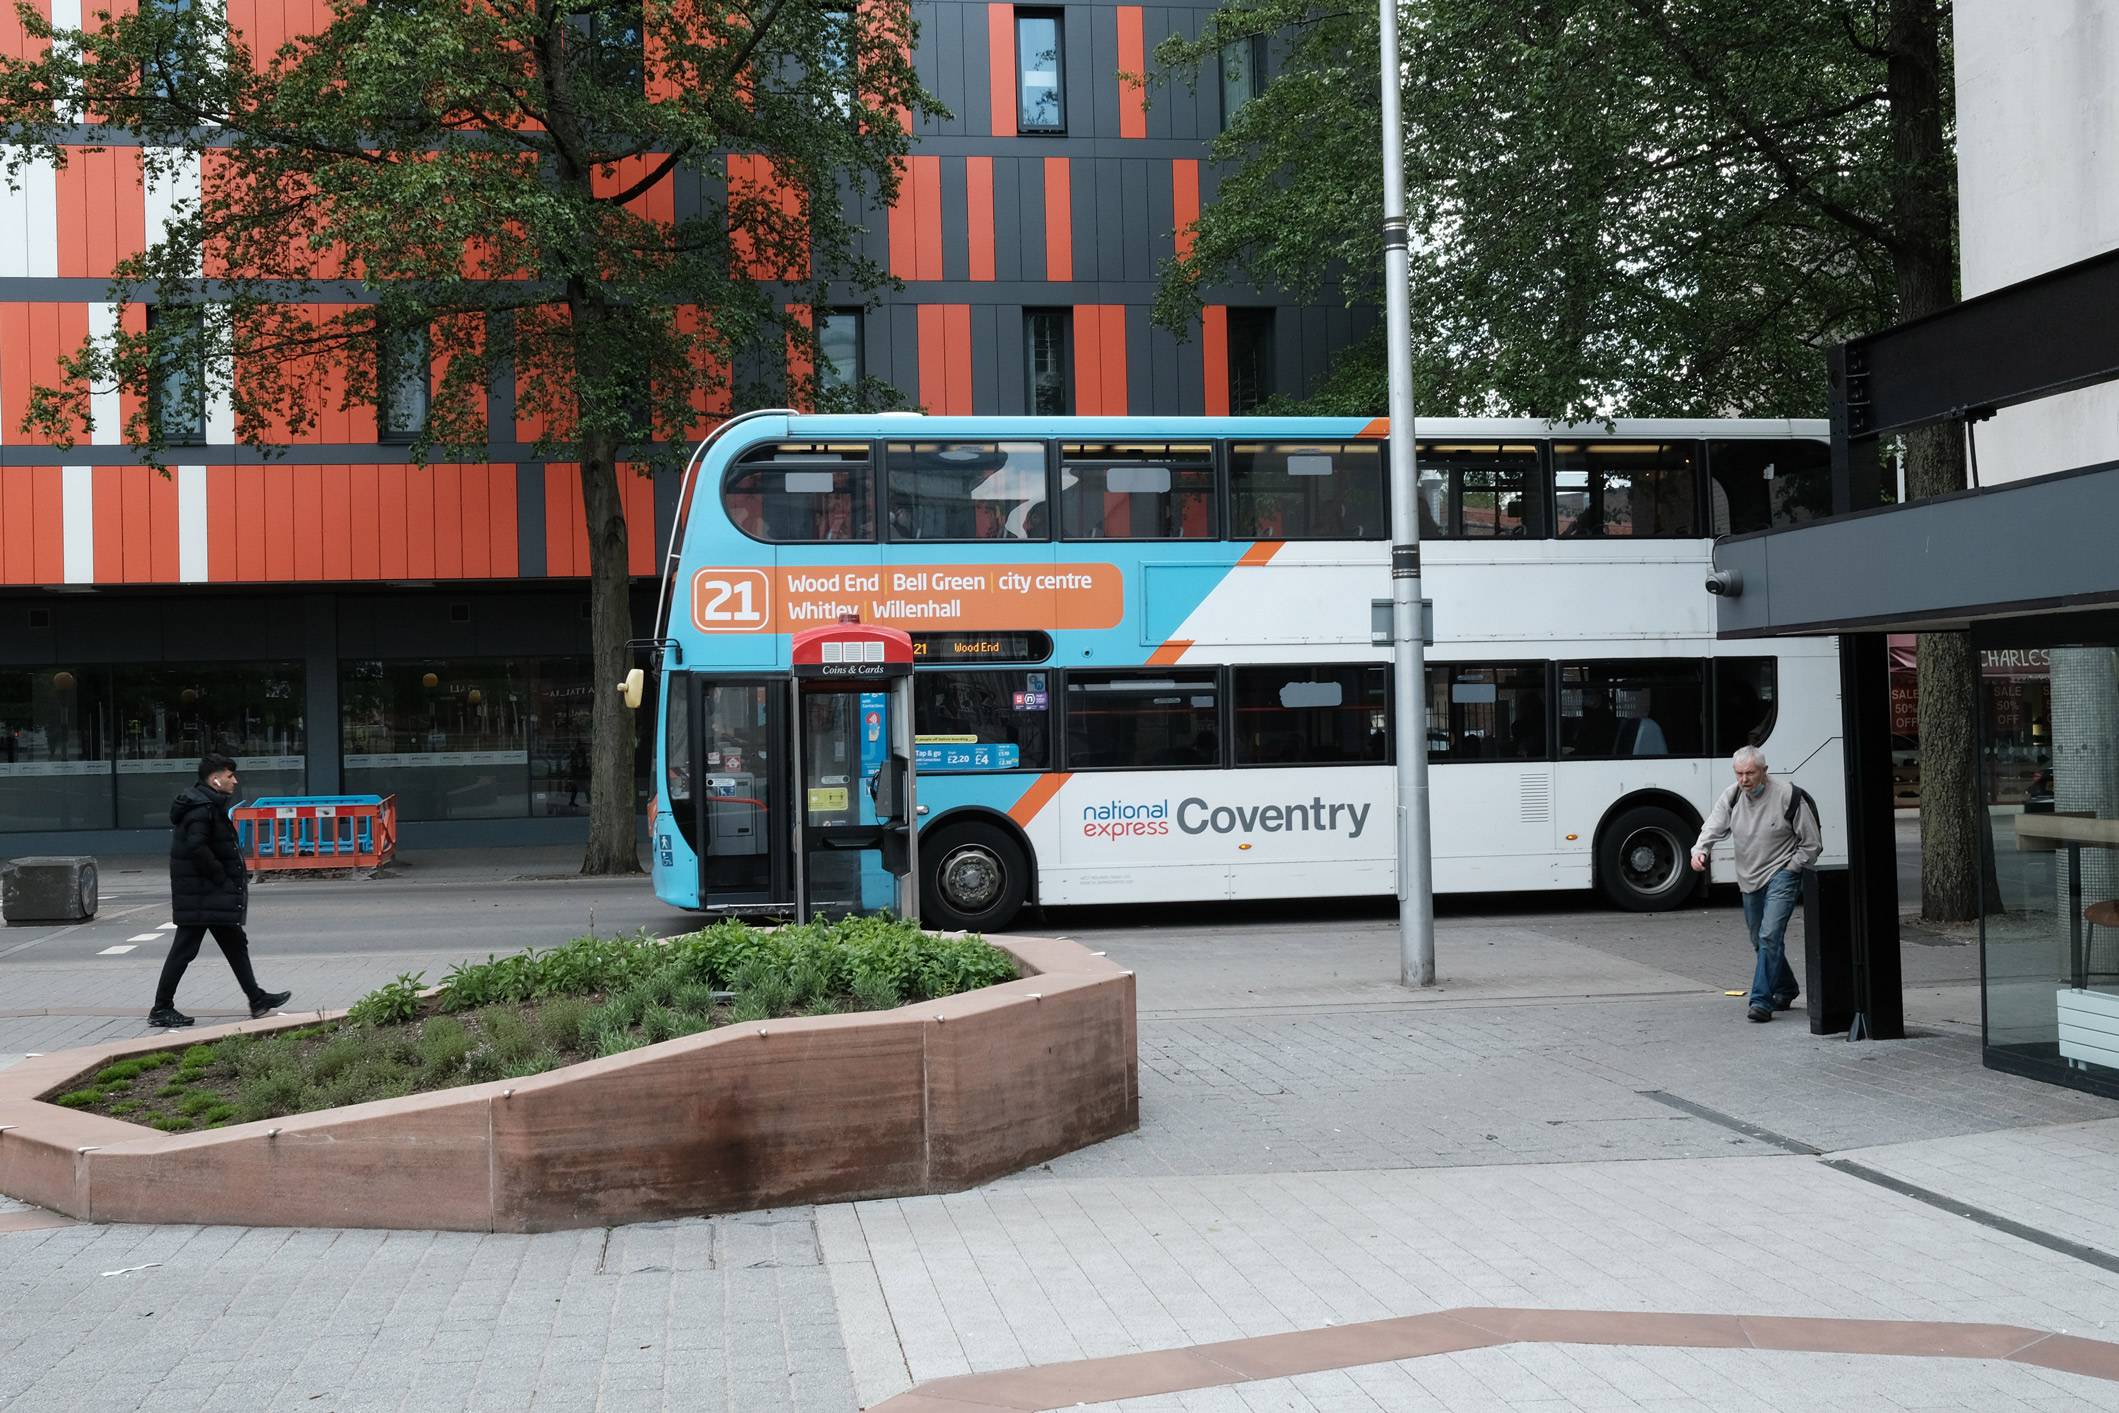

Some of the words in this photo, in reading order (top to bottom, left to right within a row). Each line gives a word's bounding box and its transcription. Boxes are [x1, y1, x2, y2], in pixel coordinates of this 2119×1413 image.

[788, 574, 840, 592] Wood
[845, 574, 879, 592] End
[893, 573, 927, 591] Bell
[932, 573, 985, 591] Green
[998, 572, 1032, 594] city
[1036, 573, 1092, 590] centre
[704, 580, 760, 621] 21
[788, 601, 858, 620] Whitley
[872, 600, 961, 619] Willenhall
[913, 643, 927, 655] 21
[954, 642, 979, 653] Wood
[981, 642, 999, 652] End
[822, 665, 847, 675] Coins
[848, 665, 857, 674] &
[858, 665, 885, 675] Cards
[1891, 688, 1919, 700] SALE
[1994, 686, 2022, 697] SALE
[1895, 703, 1918, 714] 50%
[1896, 717, 1919, 728] OFF
[1999, 714, 2021, 725] OFF
[915, 749, 927, 758] Tap
[947, 755, 970, 764] £2.20
[975, 754, 989, 765] £4
[1083, 799, 1168, 821] national
[1177, 796, 1371, 839] Coventry
[1083, 820, 1169, 842] express
